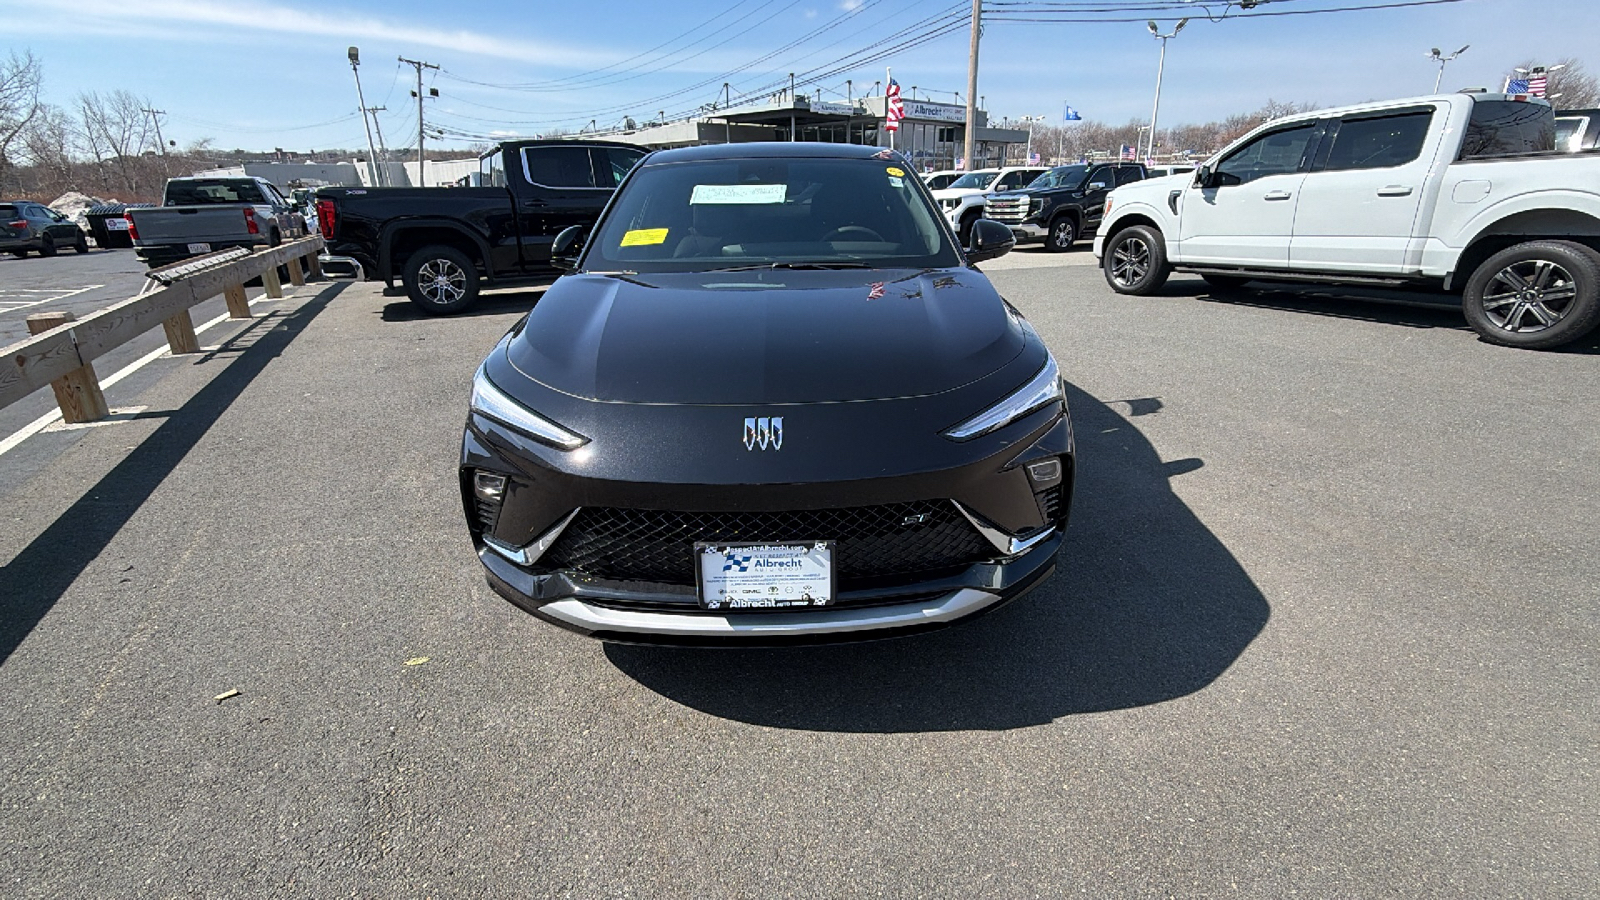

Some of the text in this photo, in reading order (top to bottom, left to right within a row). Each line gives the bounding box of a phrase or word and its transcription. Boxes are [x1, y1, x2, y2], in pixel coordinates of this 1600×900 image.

[915, 104, 942, 116] Albrecht
[754, 558, 803, 568] Albrecht
[729, 598, 776, 608] Albrecht
